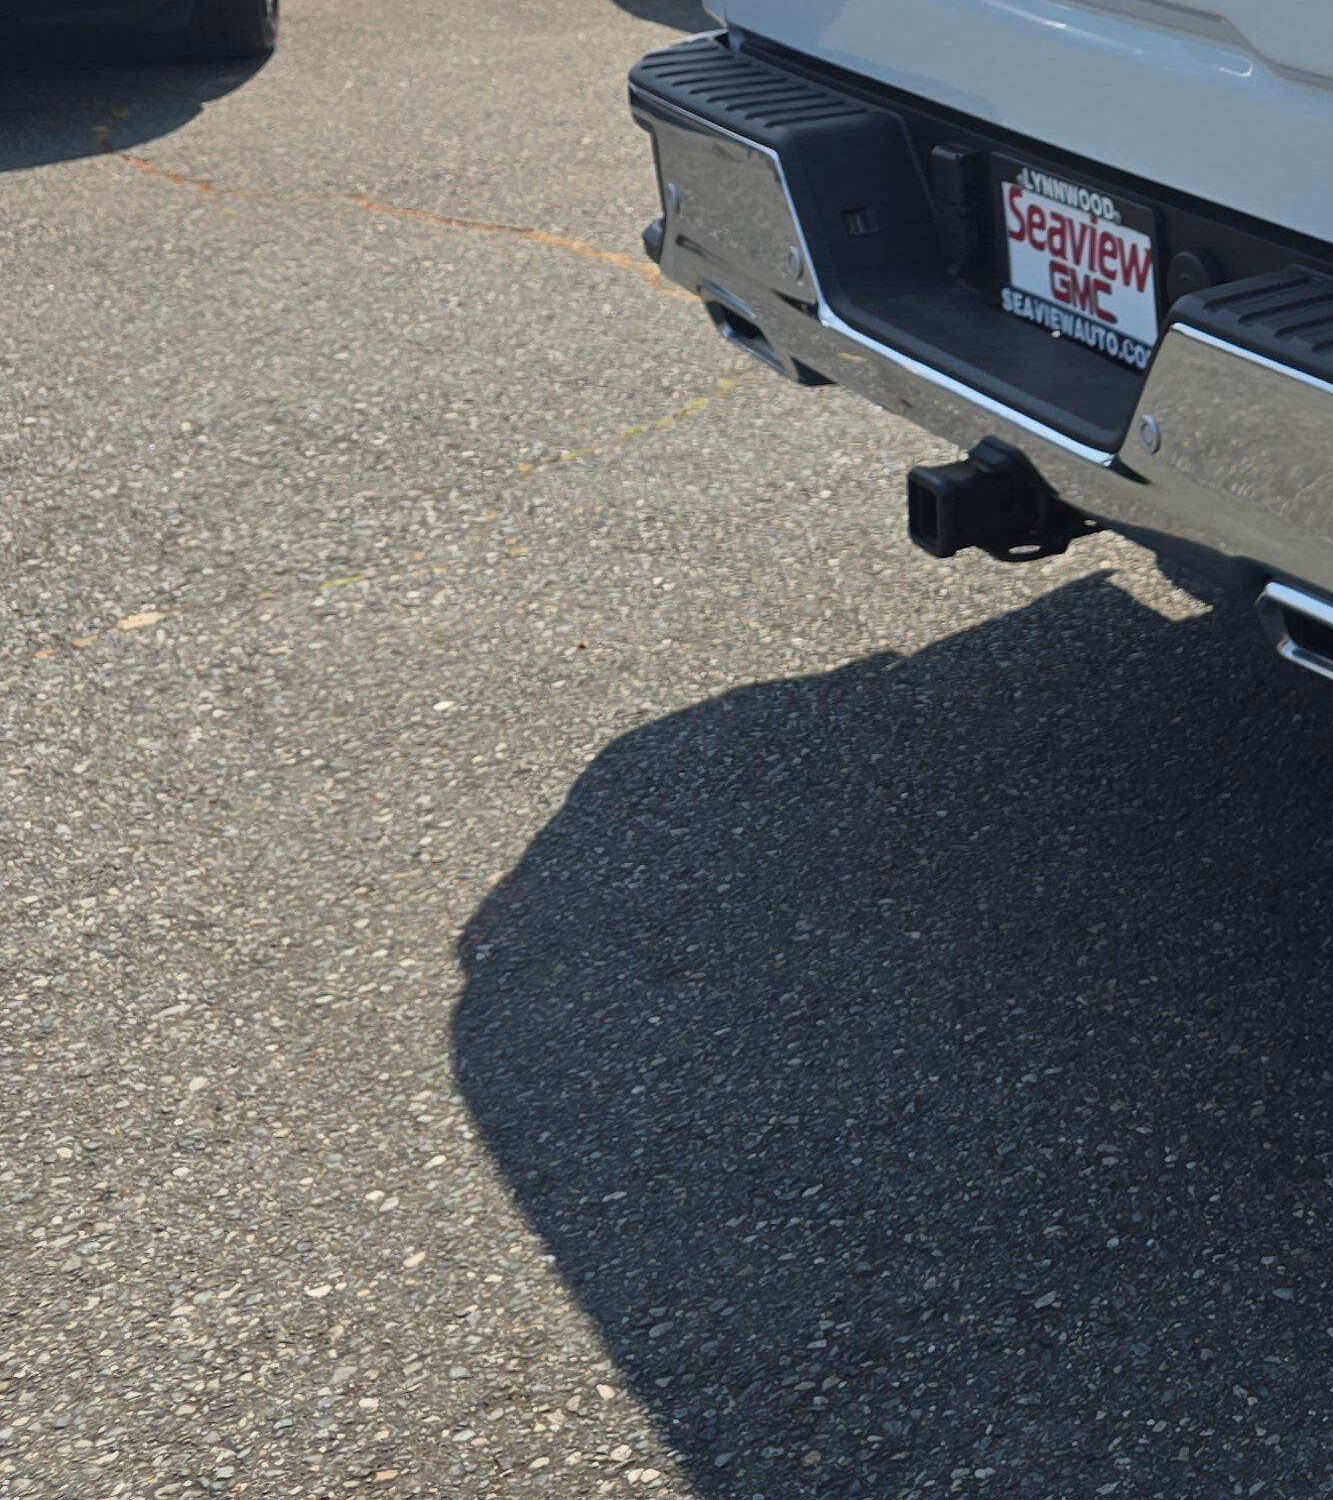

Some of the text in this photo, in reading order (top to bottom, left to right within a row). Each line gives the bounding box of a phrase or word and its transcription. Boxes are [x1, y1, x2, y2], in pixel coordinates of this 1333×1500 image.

[1021, 167, 1116, 220] LYNNWOOD
[1008, 185, 1152, 293] Seaview
[1001, 287, 1151, 370] SEAVIEWAUTO.CO
[1048, 259, 1119, 324] GMC
